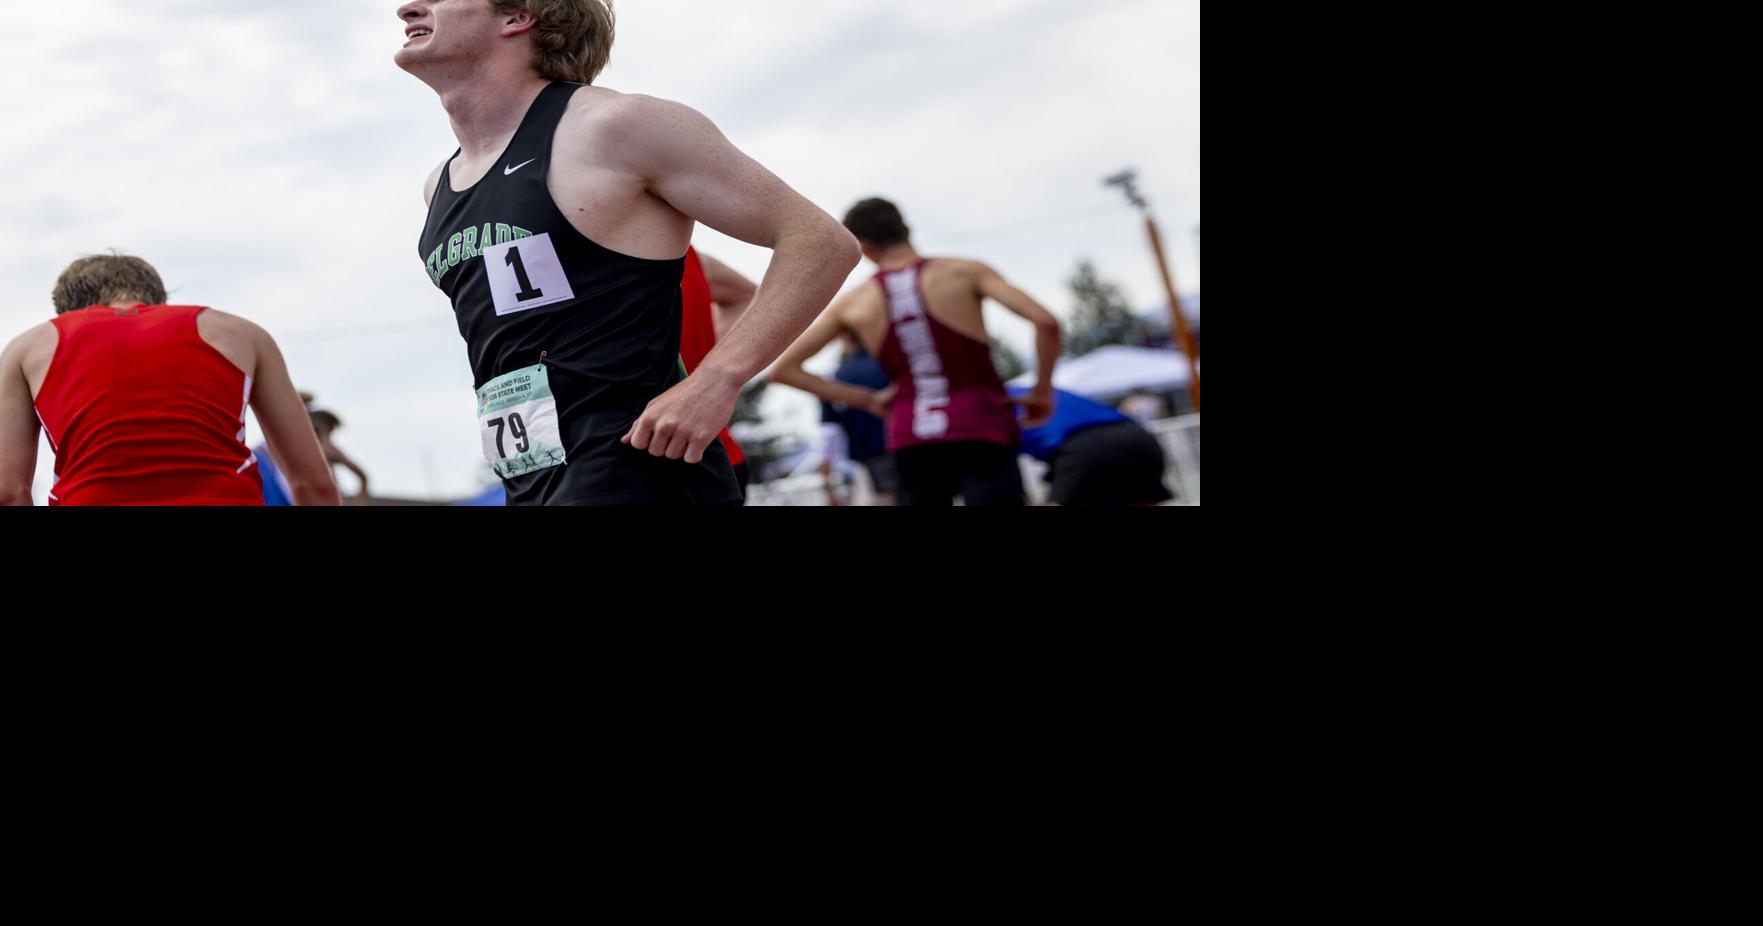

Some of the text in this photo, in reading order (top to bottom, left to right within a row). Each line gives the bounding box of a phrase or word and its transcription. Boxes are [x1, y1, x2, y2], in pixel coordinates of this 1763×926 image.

[426, 222, 533, 288] ELGRAD
[504, 246, 544, 302] 1
[497, 388, 514, 398] STATE
[515, 382, 531, 392] MEET
[500, 380, 513, 389] AND
[513, 375, 531, 384] FIELD
[487, 412, 530, 459] 79
